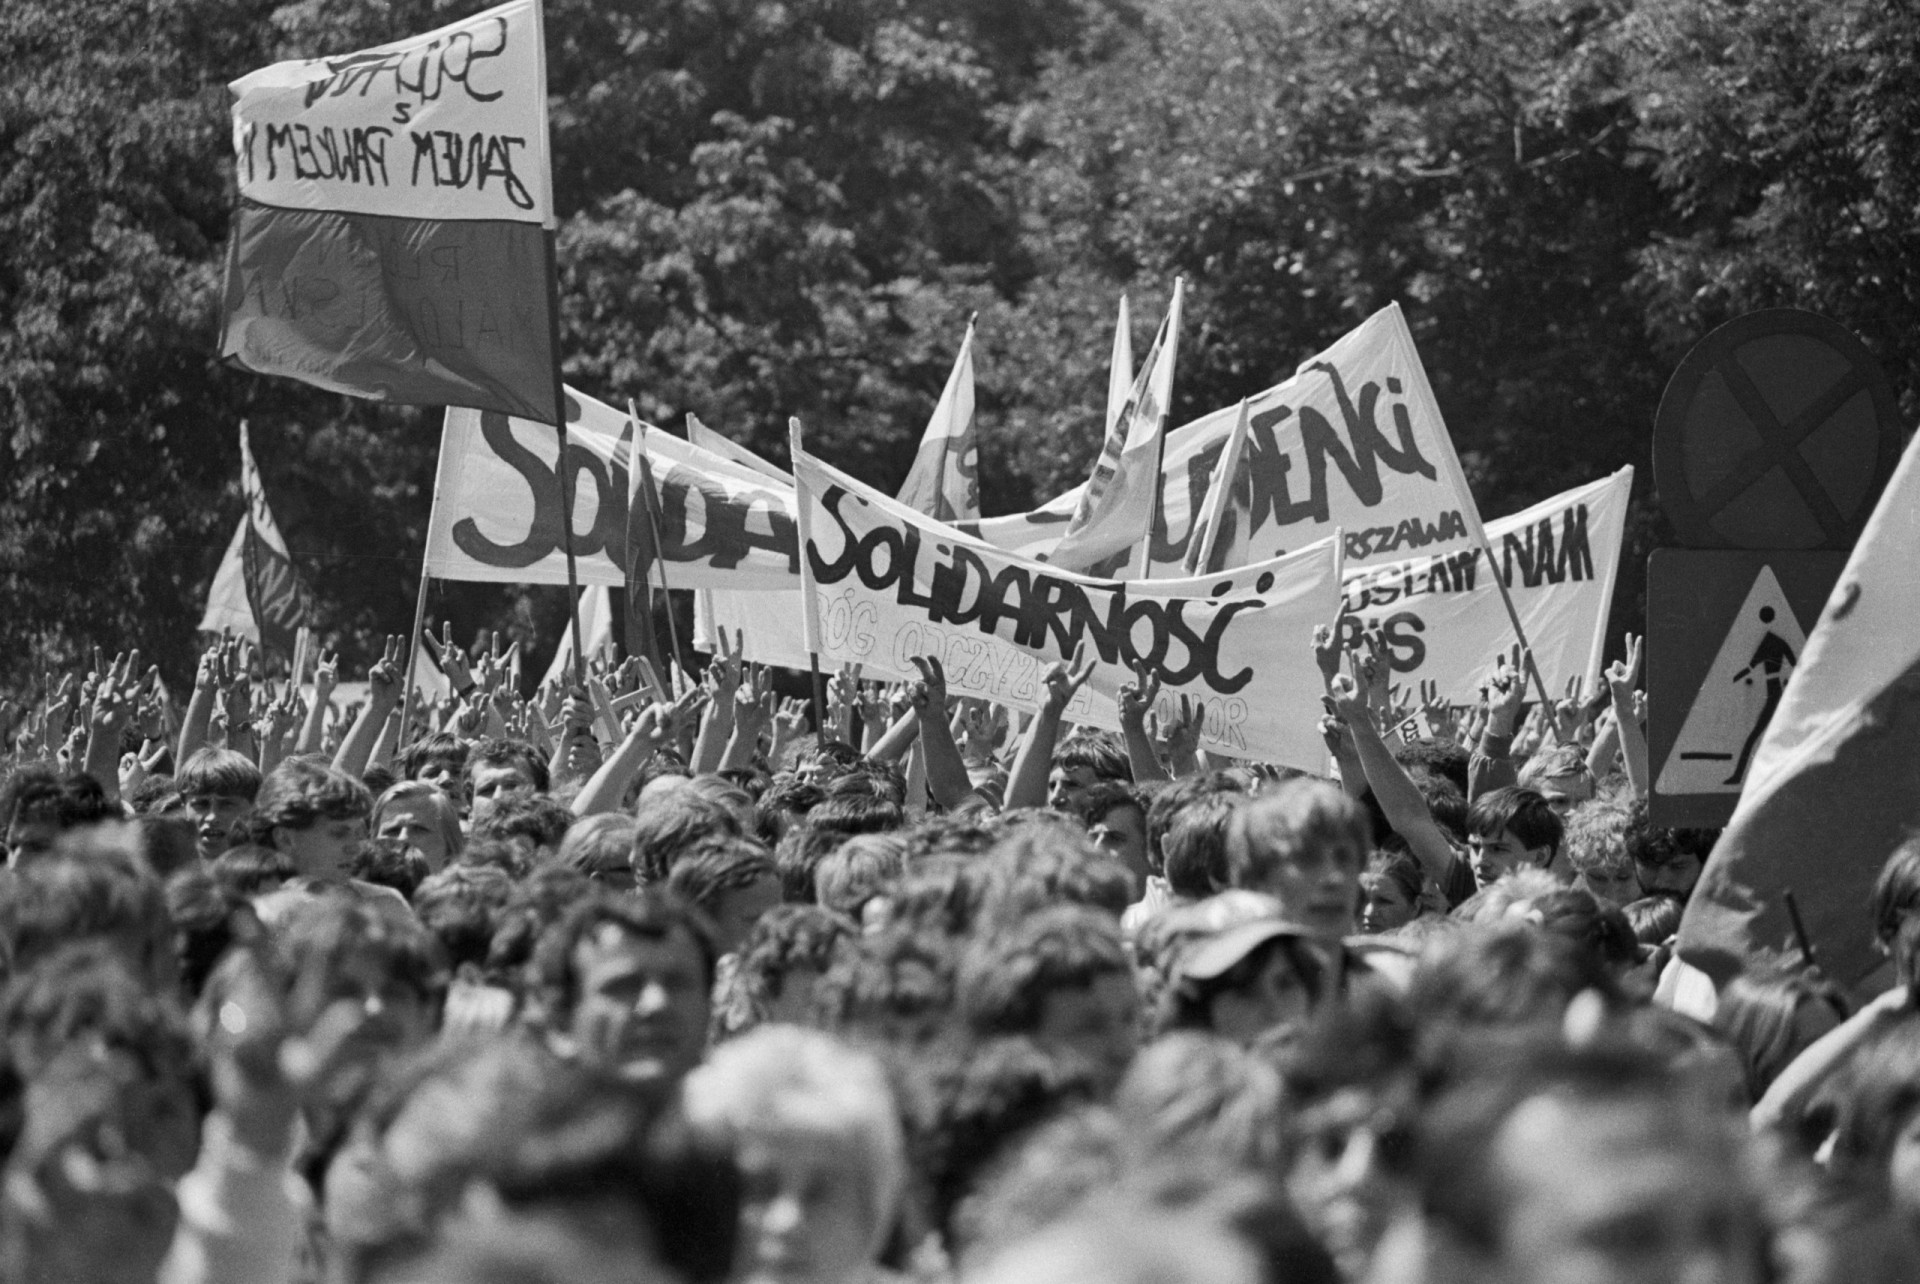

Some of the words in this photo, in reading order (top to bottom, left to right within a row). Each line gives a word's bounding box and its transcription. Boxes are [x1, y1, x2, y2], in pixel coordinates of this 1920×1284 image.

[1344, 510, 1468, 560] RSZAWA
[1502, 503, 1594, 588] NAM
[893, 621, 1094, 715] OJCZYZA
